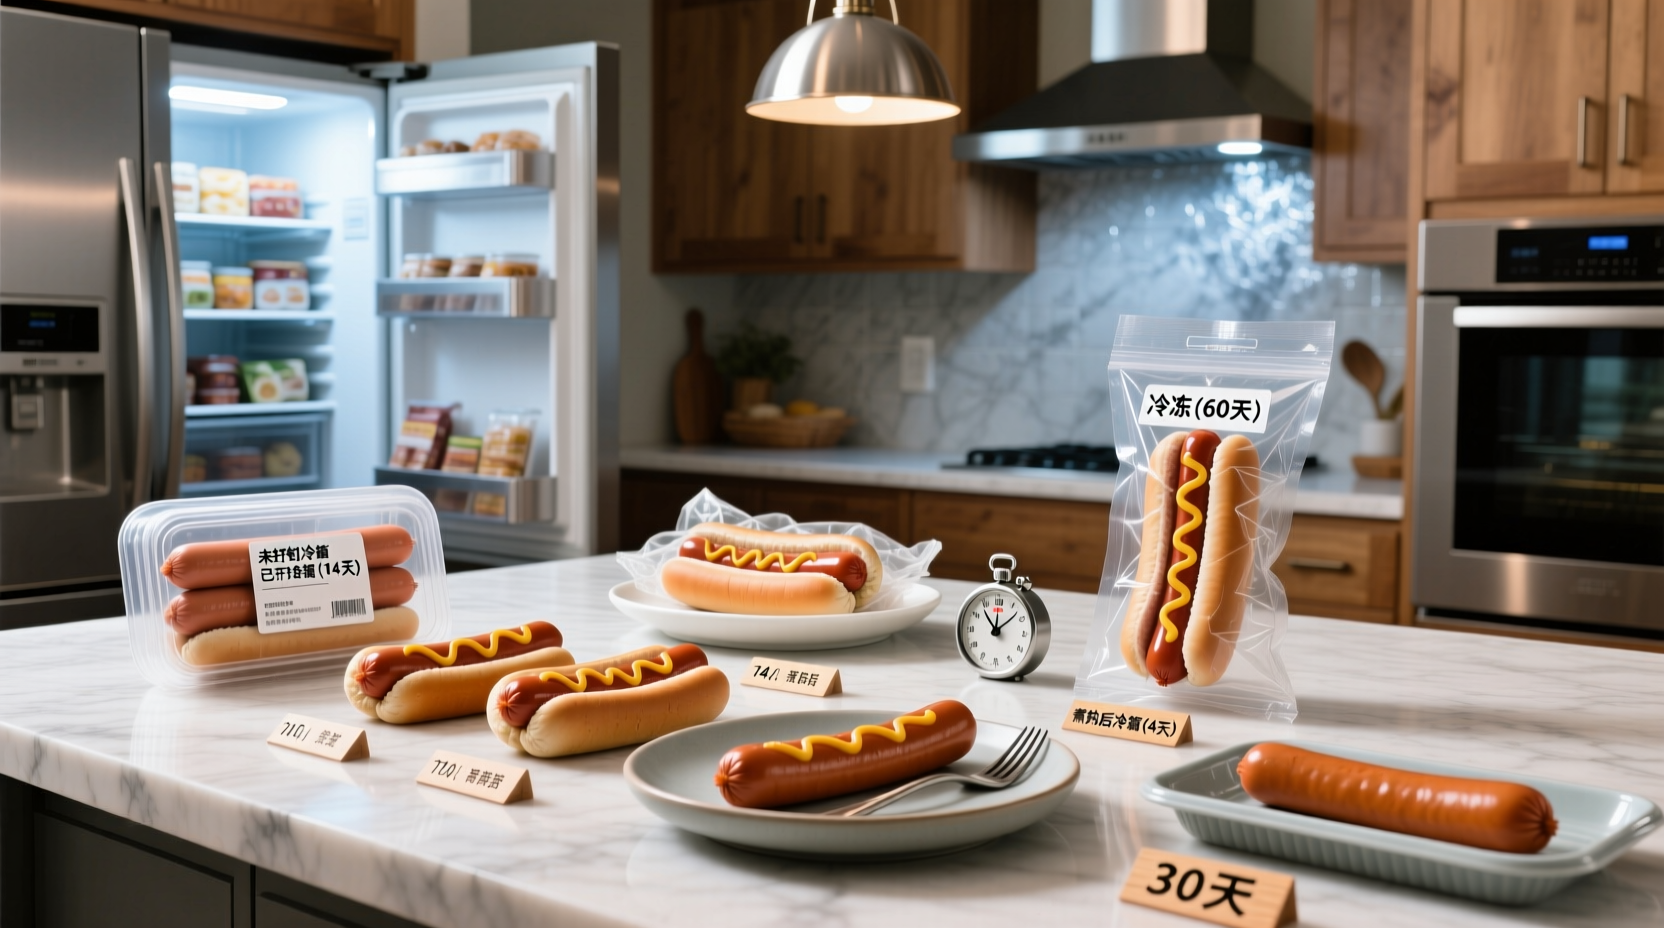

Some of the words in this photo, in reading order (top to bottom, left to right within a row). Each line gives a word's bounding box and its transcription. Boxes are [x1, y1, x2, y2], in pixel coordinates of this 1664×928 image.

[1147, 393, 1261, 424] 冷冻(60天)
[1146, 862, 1256, 916] 30天
